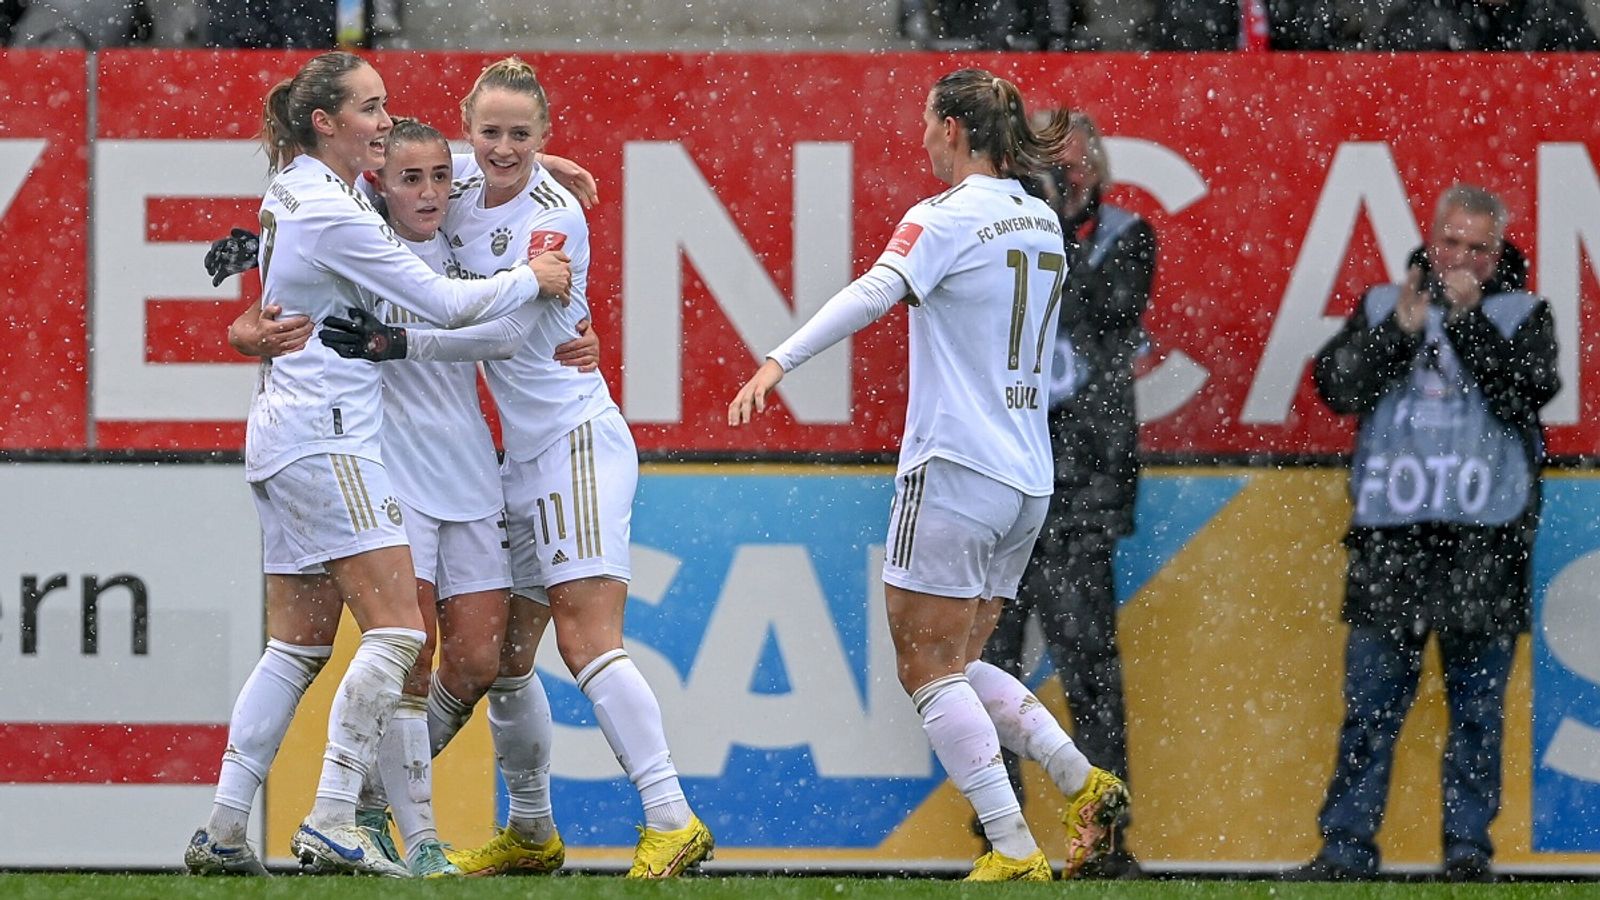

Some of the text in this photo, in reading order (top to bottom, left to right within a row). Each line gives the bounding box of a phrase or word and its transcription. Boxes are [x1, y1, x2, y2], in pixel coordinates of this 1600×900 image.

[976, 215, 1063, 244] FC BAYERN MÜNC
[1006, 249, 1065, 374] 17
[1355, 453, 1490, 515] FOTO
[536, 492, 567, 545] 11
[0, 572, 151, 656] rn
